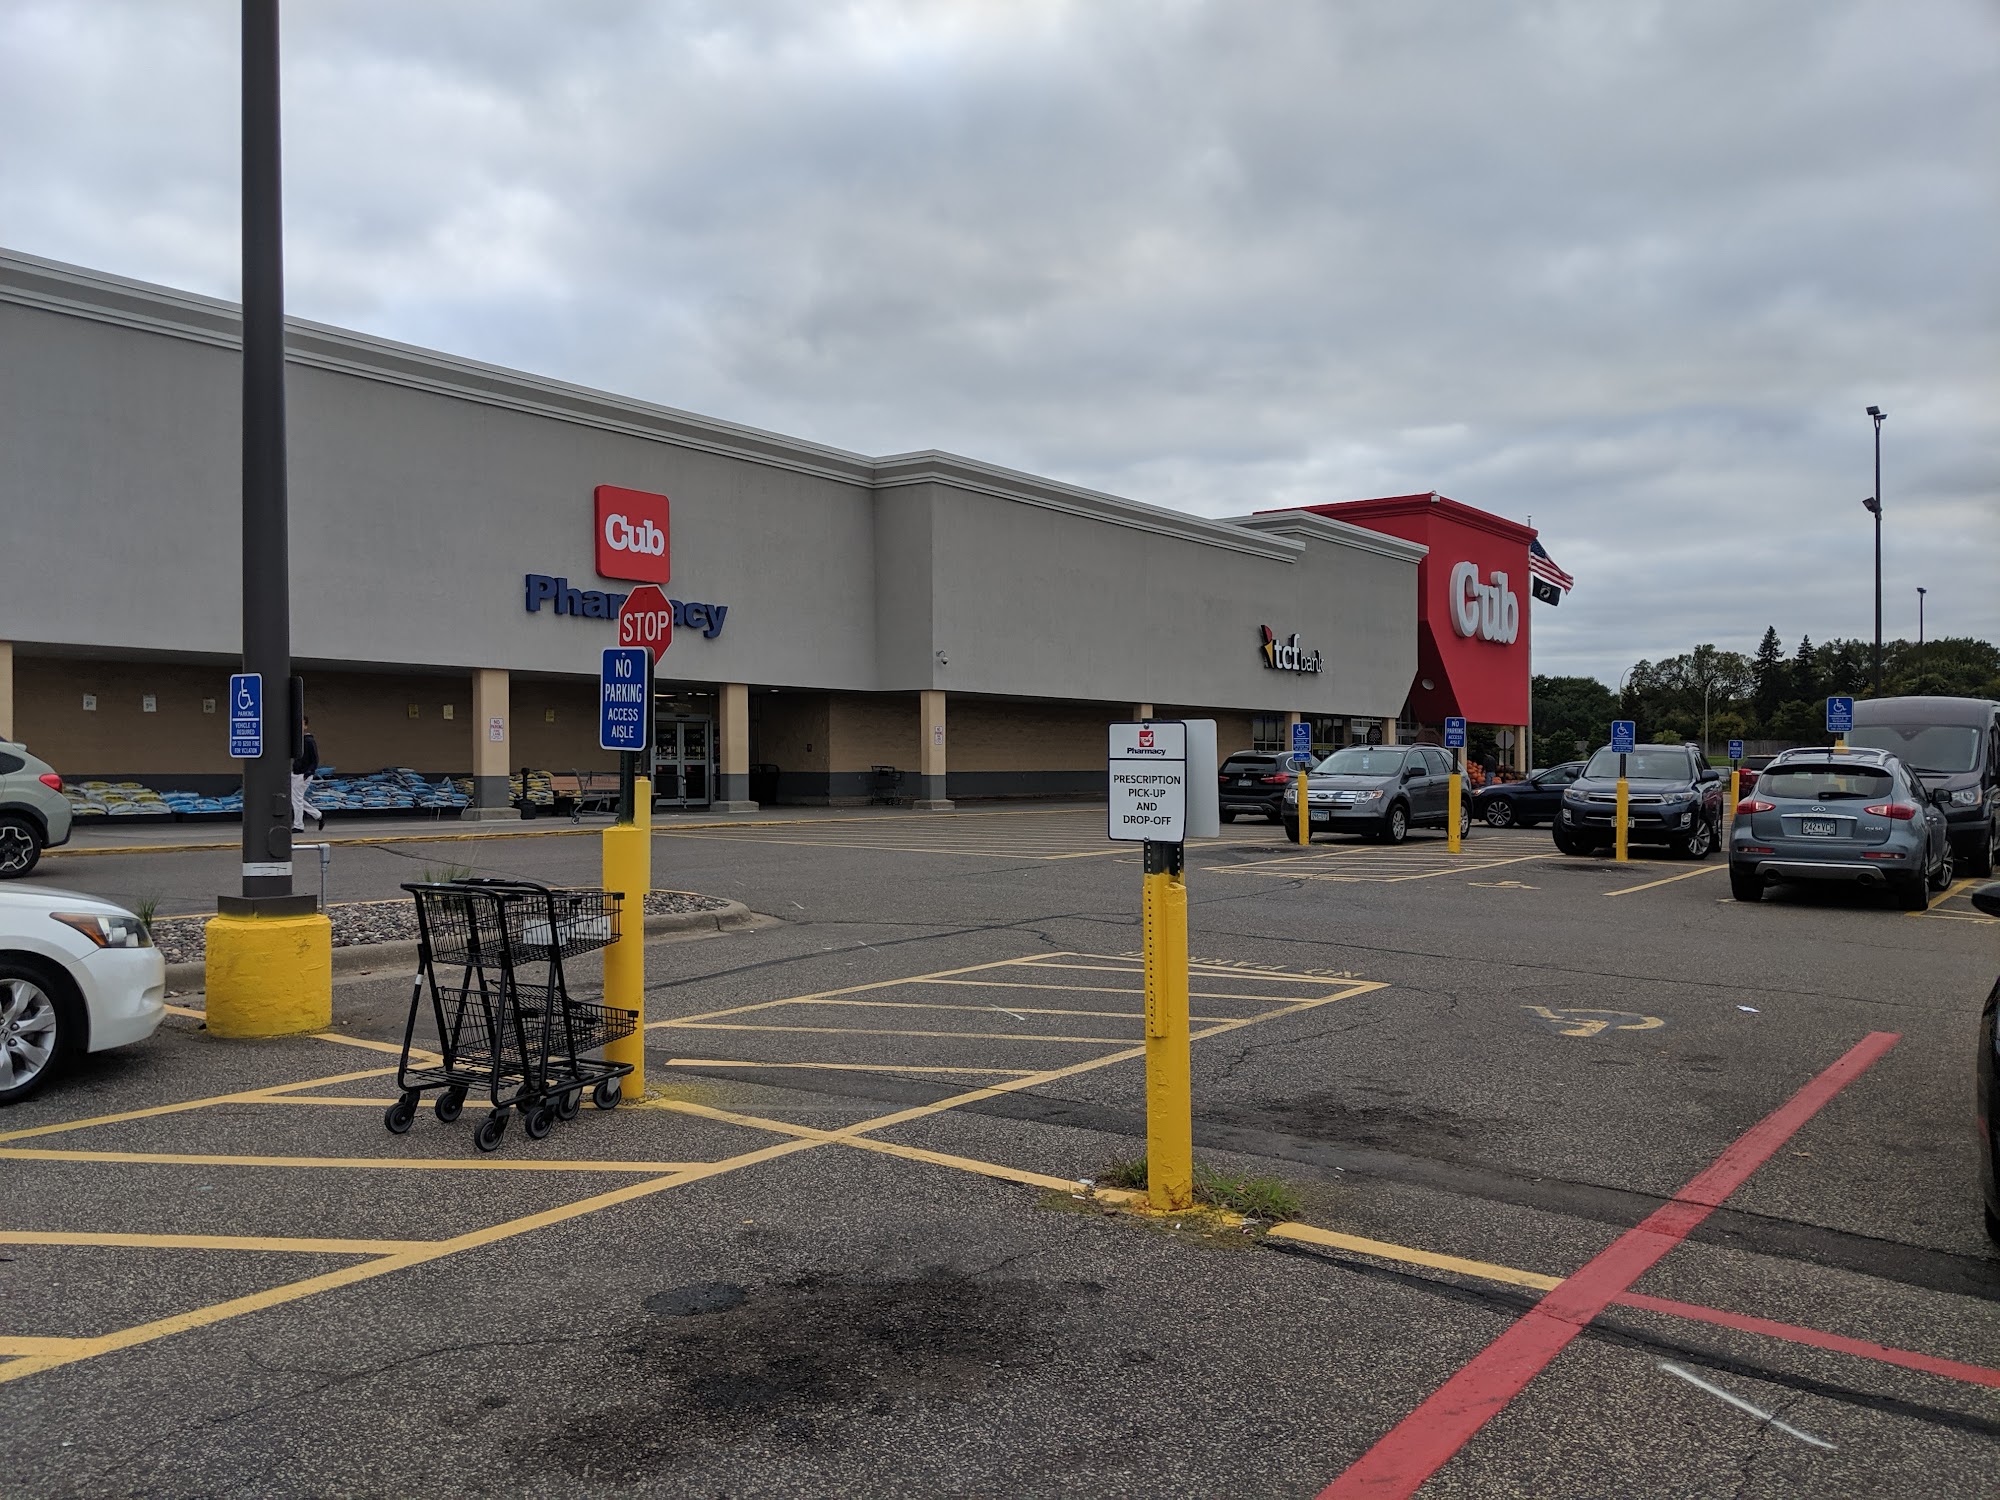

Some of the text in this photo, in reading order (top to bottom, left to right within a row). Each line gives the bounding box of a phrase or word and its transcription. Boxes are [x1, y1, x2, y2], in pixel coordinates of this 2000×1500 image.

[605, 513, 665, 557] Cub
[525, 574, 728, 639] Pharacy
[1450, 560, 1519, 645] Cub
[622, 611, 669, 642] STOP
[615, 659, 632, 678] NO
[604, 683, 642, 703] PARKING
[607, 707, 639, 722] ACCESS
[611, 726, 634, 739] AISLE
[1126, 747, 1166, 756] Pharmacy
[1113, 775, 1181, 785] PRESCRIPTION
[1128, 789, 1166, 798] PICK-UP
[1136, 802, 1158, 811] AND
[1123, 815, 1172, 825] DROP-OFF
